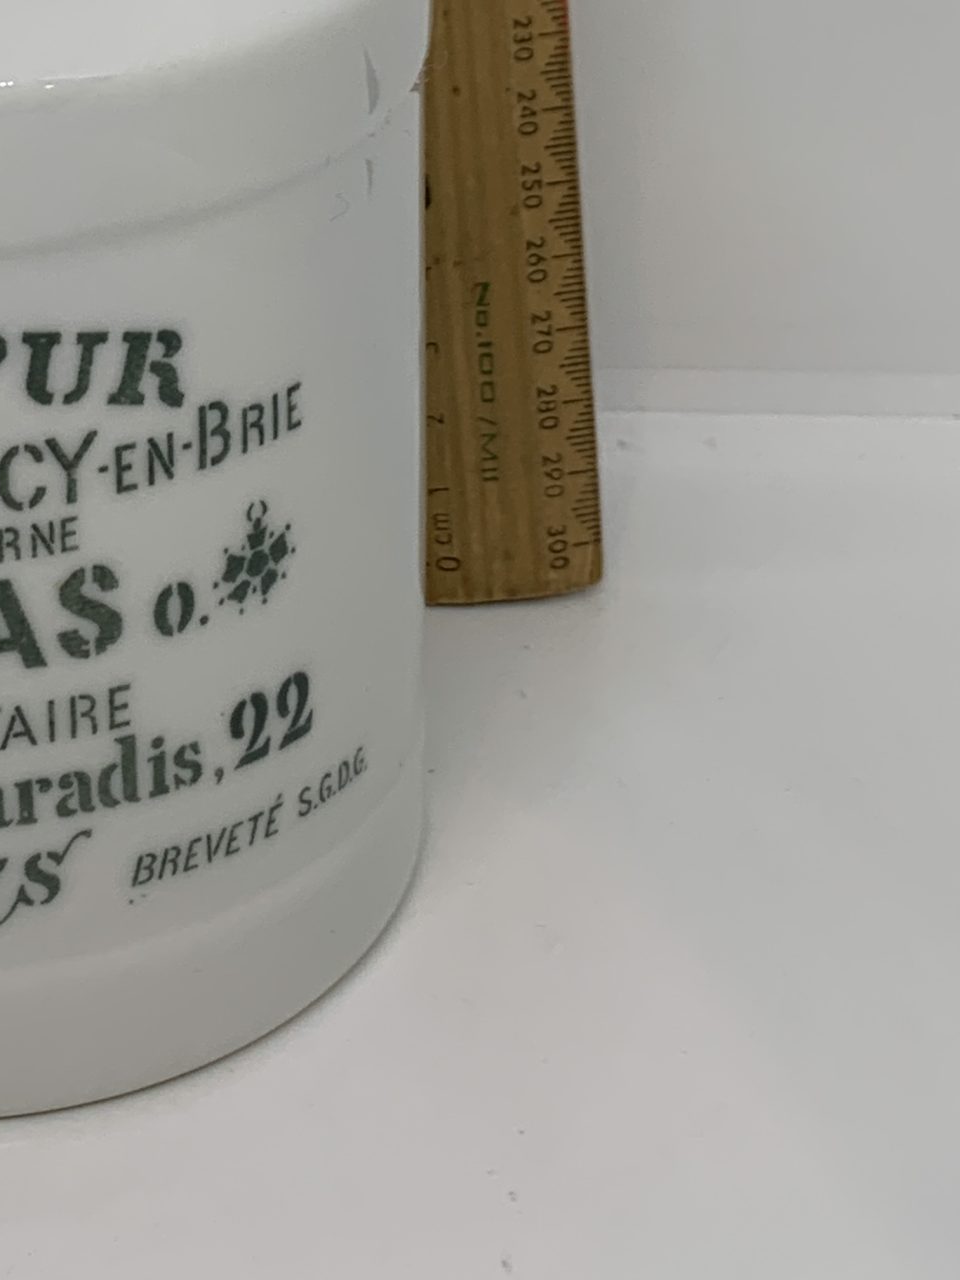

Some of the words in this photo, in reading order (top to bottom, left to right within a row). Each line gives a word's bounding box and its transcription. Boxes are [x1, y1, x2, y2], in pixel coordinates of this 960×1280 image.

[512, 17, 534, 63] 230
[517, 89, 538, 136] 240
[520, 164, 541, 209] 250
[525, 238, 546, 283] 260
[530, 310, 553, 355] 270
[536, 385, 559, 431] 280
[541, 453, 563, 499] 290
[433, 513, 452, 544] cm
[545, 524, 569, 570] 300
[436, 557, 460, 571] 0
[131, 794, 285, 888] BREVETÉ
[298, 746, 368, 817] S.G.D.G.
